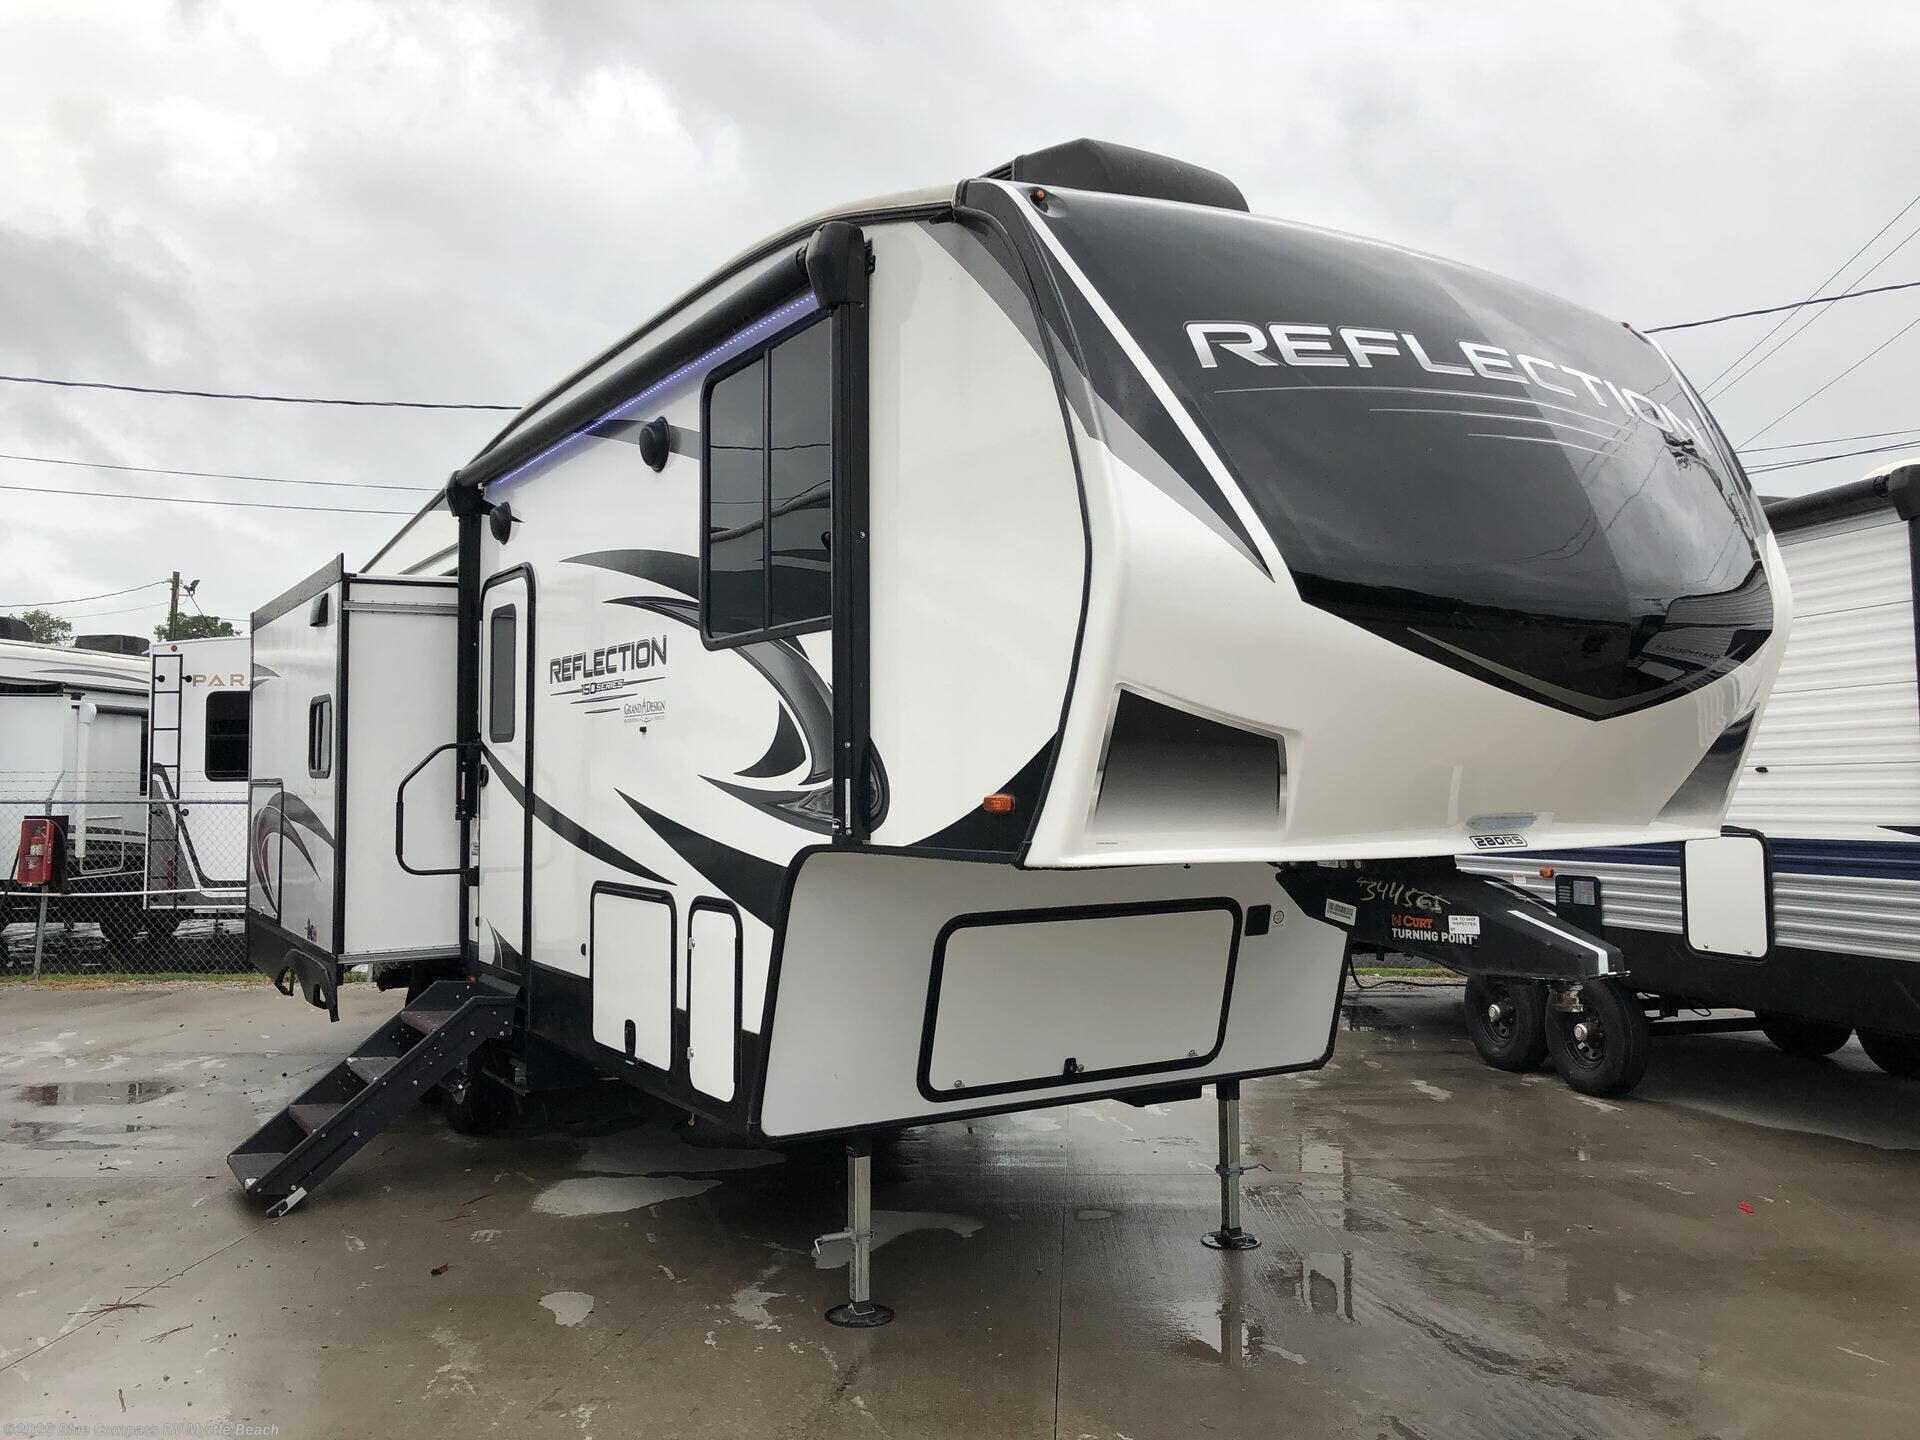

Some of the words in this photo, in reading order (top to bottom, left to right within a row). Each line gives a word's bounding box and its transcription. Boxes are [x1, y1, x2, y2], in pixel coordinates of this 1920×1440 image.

[1183, 320, 1712, 456] REFLECTION
[549, 635, 667, 684] REFLECTION
[192, 673, 250, 687] PAR
[646, 700, 666, 712] DESIGN
[1474, 834, 1523, 847] 280RS
[1391, 928, 1439, 941] TURNING
